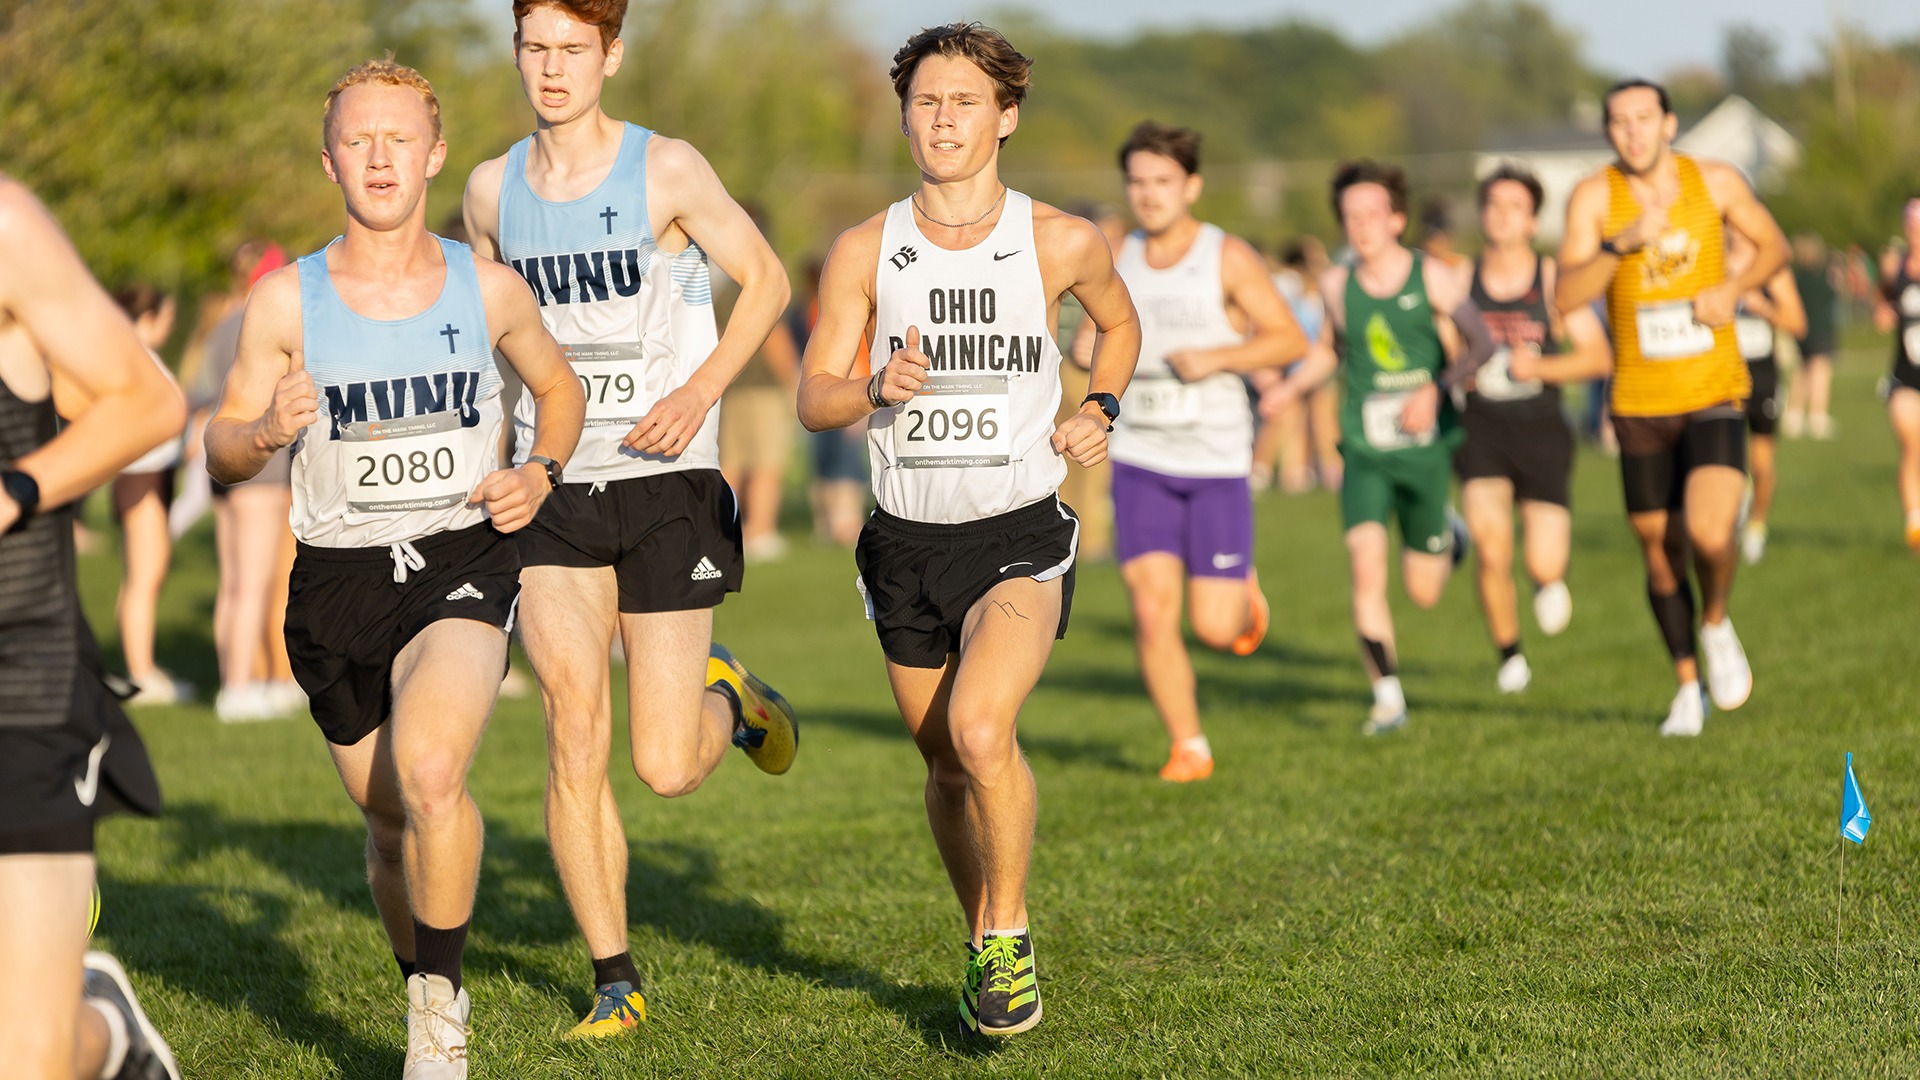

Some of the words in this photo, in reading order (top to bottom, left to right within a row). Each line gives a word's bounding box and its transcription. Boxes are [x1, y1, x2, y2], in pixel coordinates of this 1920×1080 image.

[512, 249, 641, 305] MVNU
[929, 288, 995, 323] OHIO
[889, 335, 1042, 373] MINICAN
[578, 373, 635, 404] 079
[324, 371, 480, 440] MVNU
[392, 425, 408, 433] MARK
[905, 409, 998, 442] 2096
[357, 447, 454, 487] 2080
[914, 458, 991, 466] onthemarktiming.com
[369, 499, 451, 511] onthemarktiming.com
[691, 569, 723, 581] adidas
